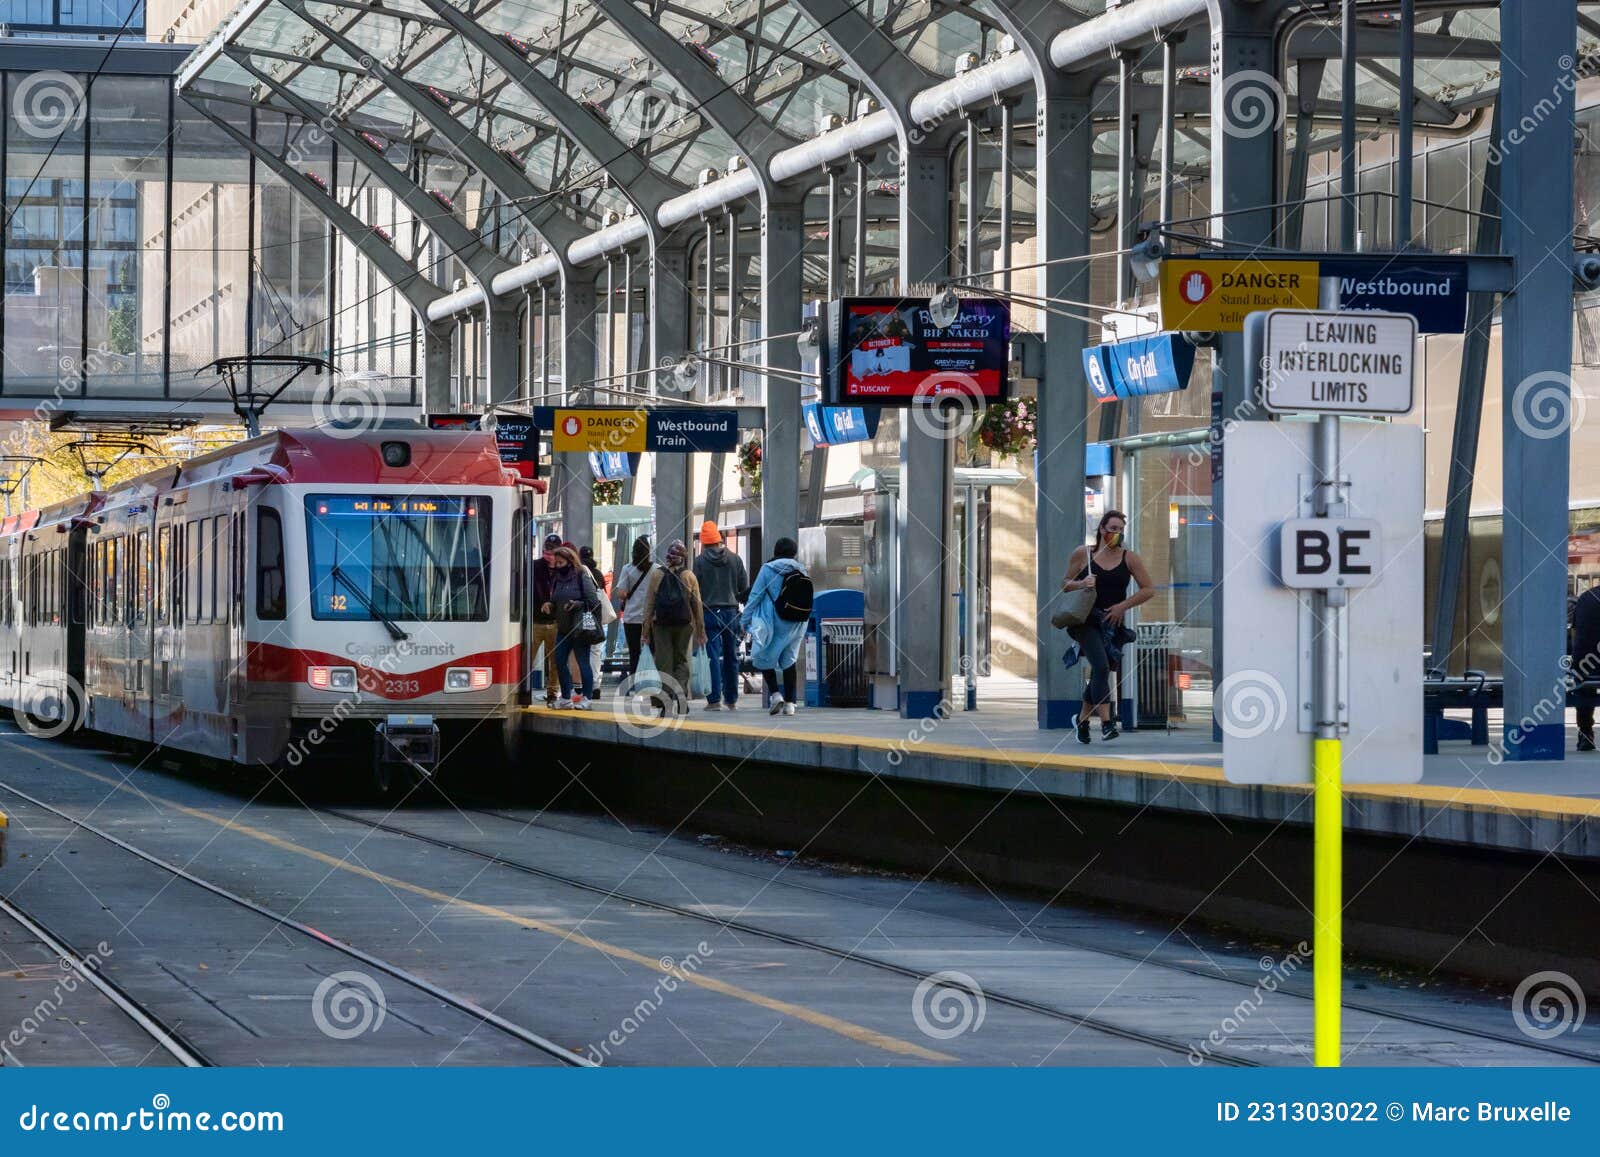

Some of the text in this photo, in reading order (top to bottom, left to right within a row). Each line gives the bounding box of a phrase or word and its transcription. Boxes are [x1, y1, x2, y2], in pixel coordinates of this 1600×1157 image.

[1221, 273, 1299, 288] DANGER
[1340, 278, 1451, 295] Westbound
[1221, 294, 1249, 305] Stand
[1253, 294, 1279, 305] Back
[1220, 312, 1245, 323] Yello
[923, 329, 989, 338] BIF NAKED
[1306, 322, 1377, 344] LEAVING
[1127, 351, 1158, 385] City Hall
[1278, 350, 1403, 374] INTERLOCKING
[860, 385, 890, 393] TUSCANY
[935, 384, 942, 394] 5
[1311, 381, 1367, 403] LIMITS
[587, 417, 635, 428] DANGER
[658, 420, 728, 431] Westbound
[656, 435, 686, 446] Train
[1296, 530, 1371, 574] BE
[385, 680, 419, 693] 2313
